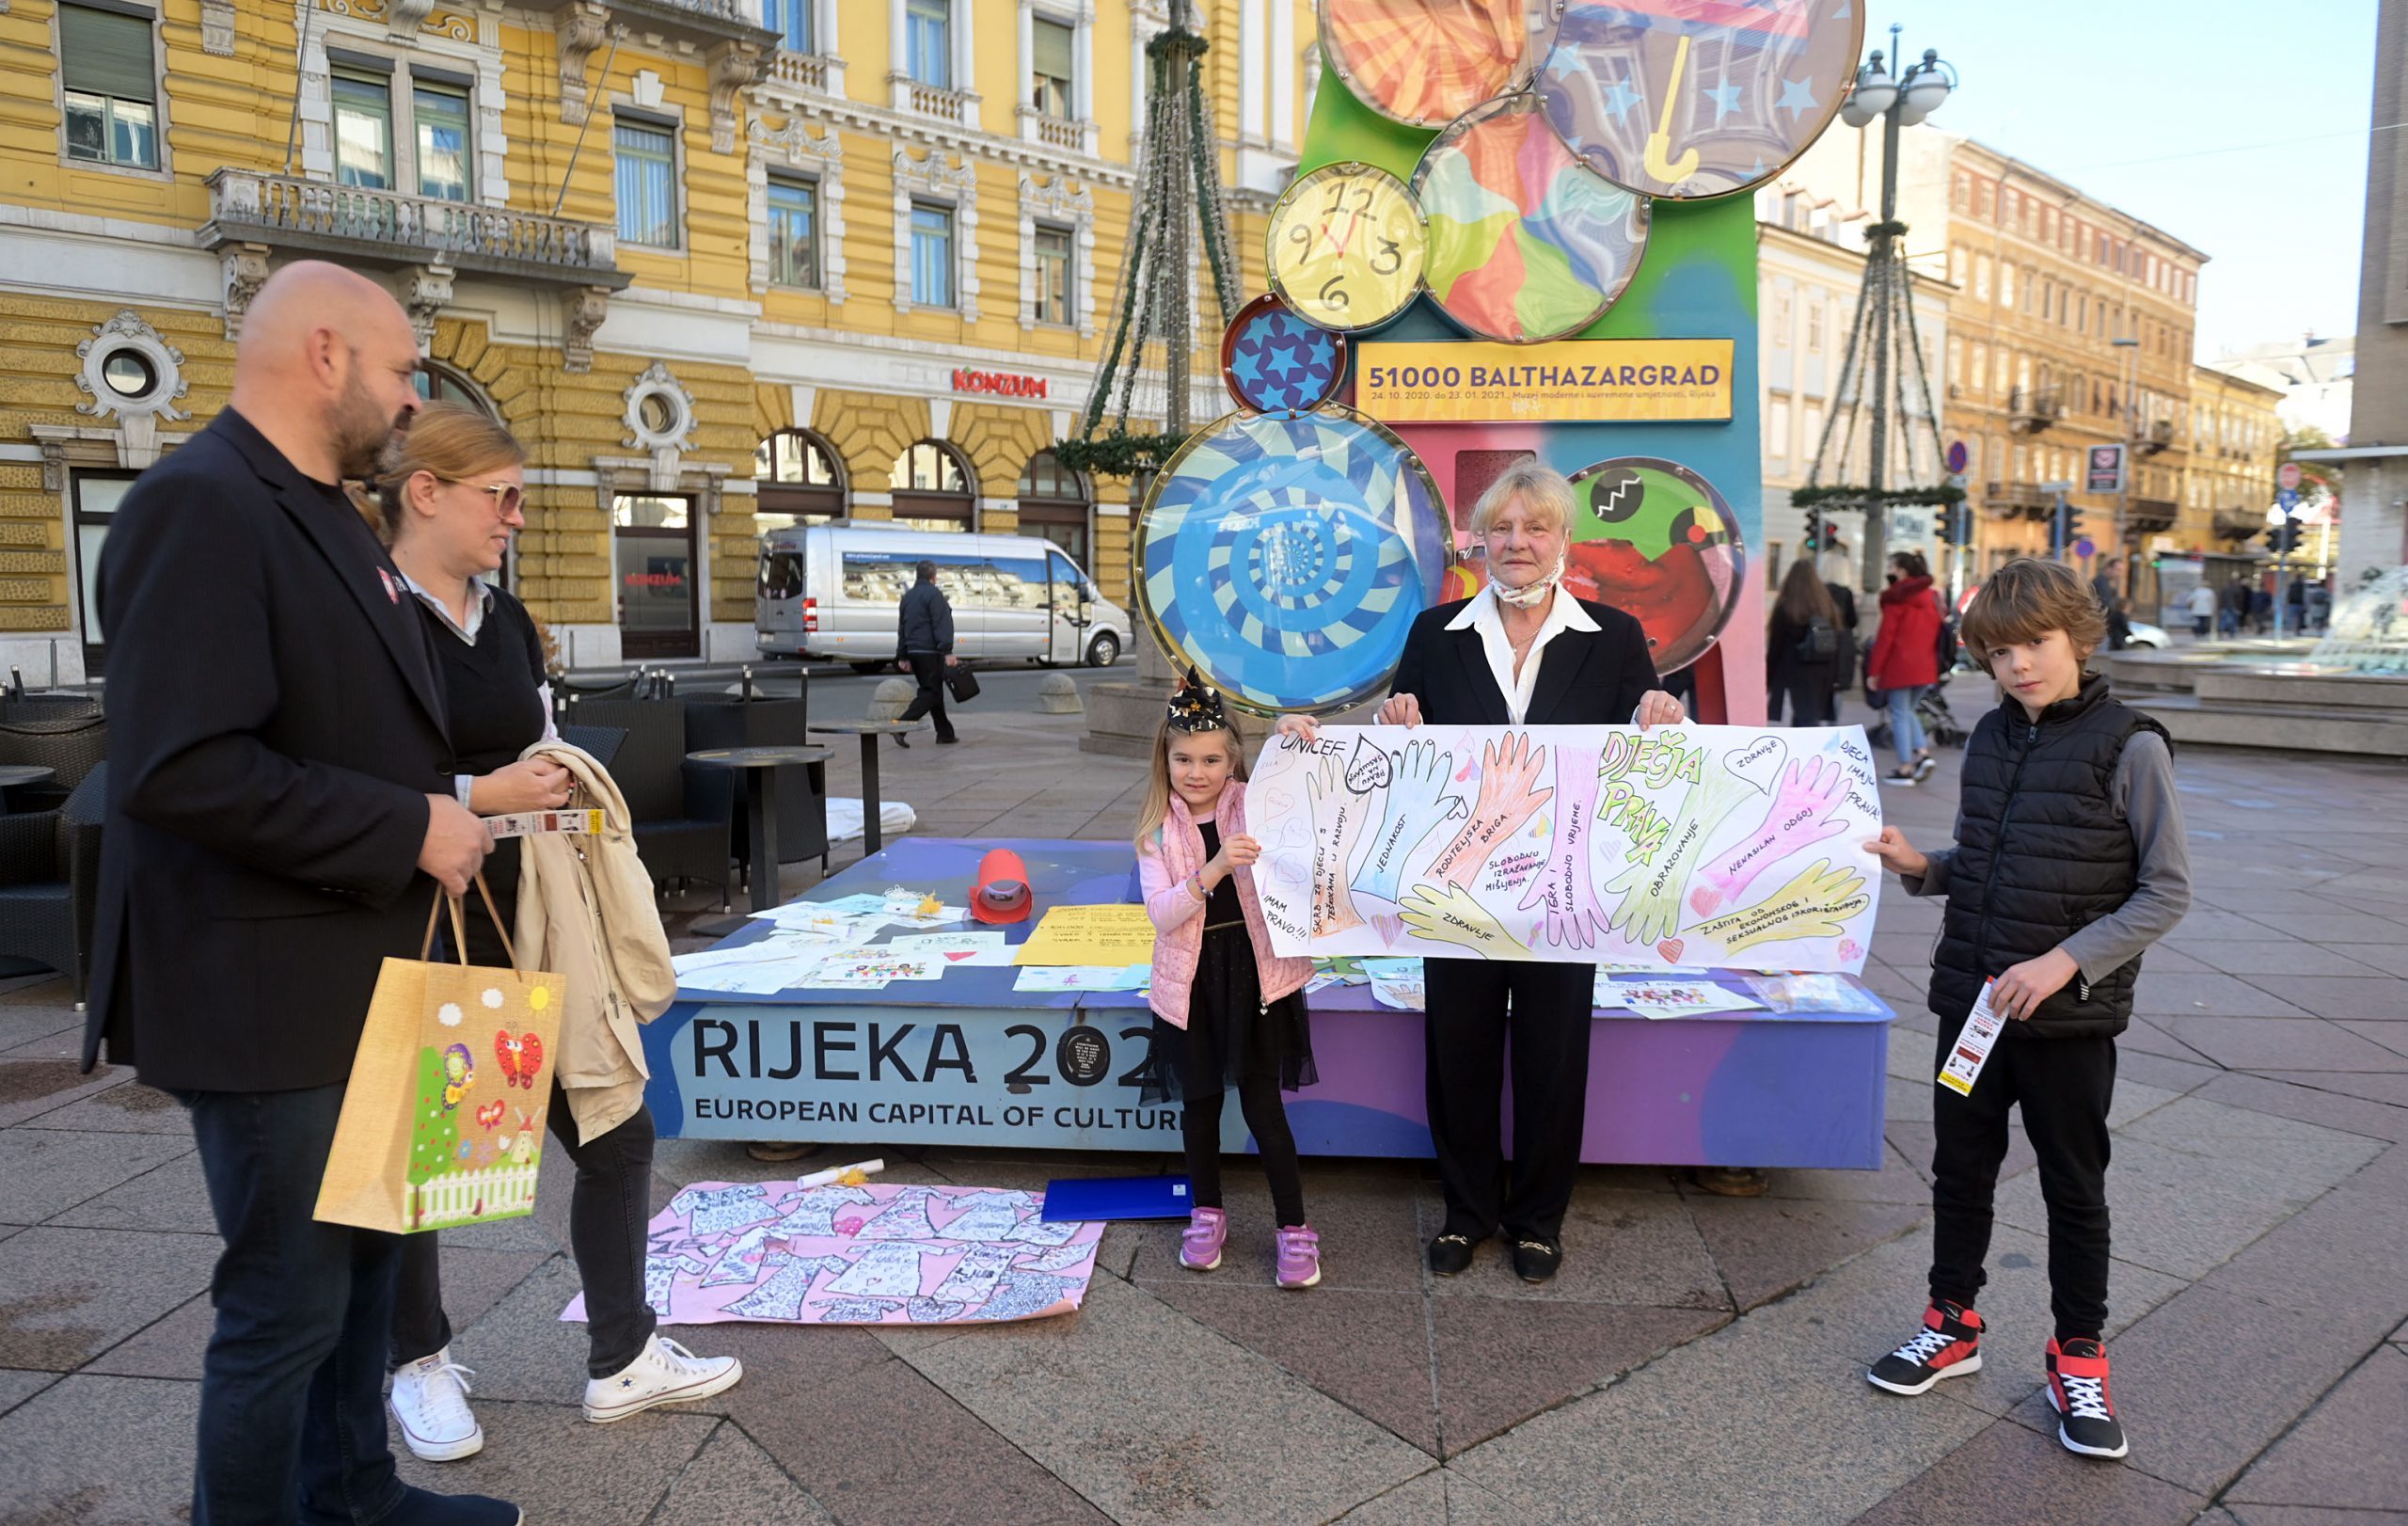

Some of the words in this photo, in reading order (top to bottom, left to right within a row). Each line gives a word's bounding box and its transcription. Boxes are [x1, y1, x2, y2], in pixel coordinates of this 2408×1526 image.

[1323, 182, 1377, 221] 12
[1290, 224, 1312, 265] 9
[1370, 236, 1402, 275] 3
[1319, 275, 1349, 310] 6
[952, 368, 1046, 399] KONZUM
[1370, 366, 1461, 388] 51000
[1470, 365, 1719, 387] BALTHAZARGRAD
[1512, 391, 1538, 400] Muzej
[1280, 734, 1347, 755] UNICEF
[1597, 730, 1703, 789] DJEČJA
[1840, 739, 1868, 763] DJECA
[1846, 764, 1876, 787] IMAJU
[1596, 781, 1671, 867] PRAVA
[1376, 814, 1406, 873] JEDNAKOST
[1436, 819, 1483, 878] RODITELJSKA
[1728, 835, 1776, 876] NENASILAN
[1783, 807, 1813, 831] ODGOJ
[1316, 847, 1325, 877] DJECU
[1651, 819, 1699, 898] OBRAZOVANJE
[1563, 854, 1574, 912] SLOBODNO
[1263, 895, 1287, 913] IMAM
[1738, 900, 1799, 930] EKONOMSKOG
[1442, 913, 1495, 941] ZDRAVLJE
[1700, 917, 1741, 935] ZAŠTITA
[1725, 915, 1789, 945] SEKSUALNOG
[693, 1019, 978, 1084] RIJEKA
[1004, 1023, 1163, 1088] 202
[695, 1098, 858, 1123] EUROPEAN
[868, 1102, 993, 1127] CAPITAL
[1003, 1105, 1043, 1127] OF
